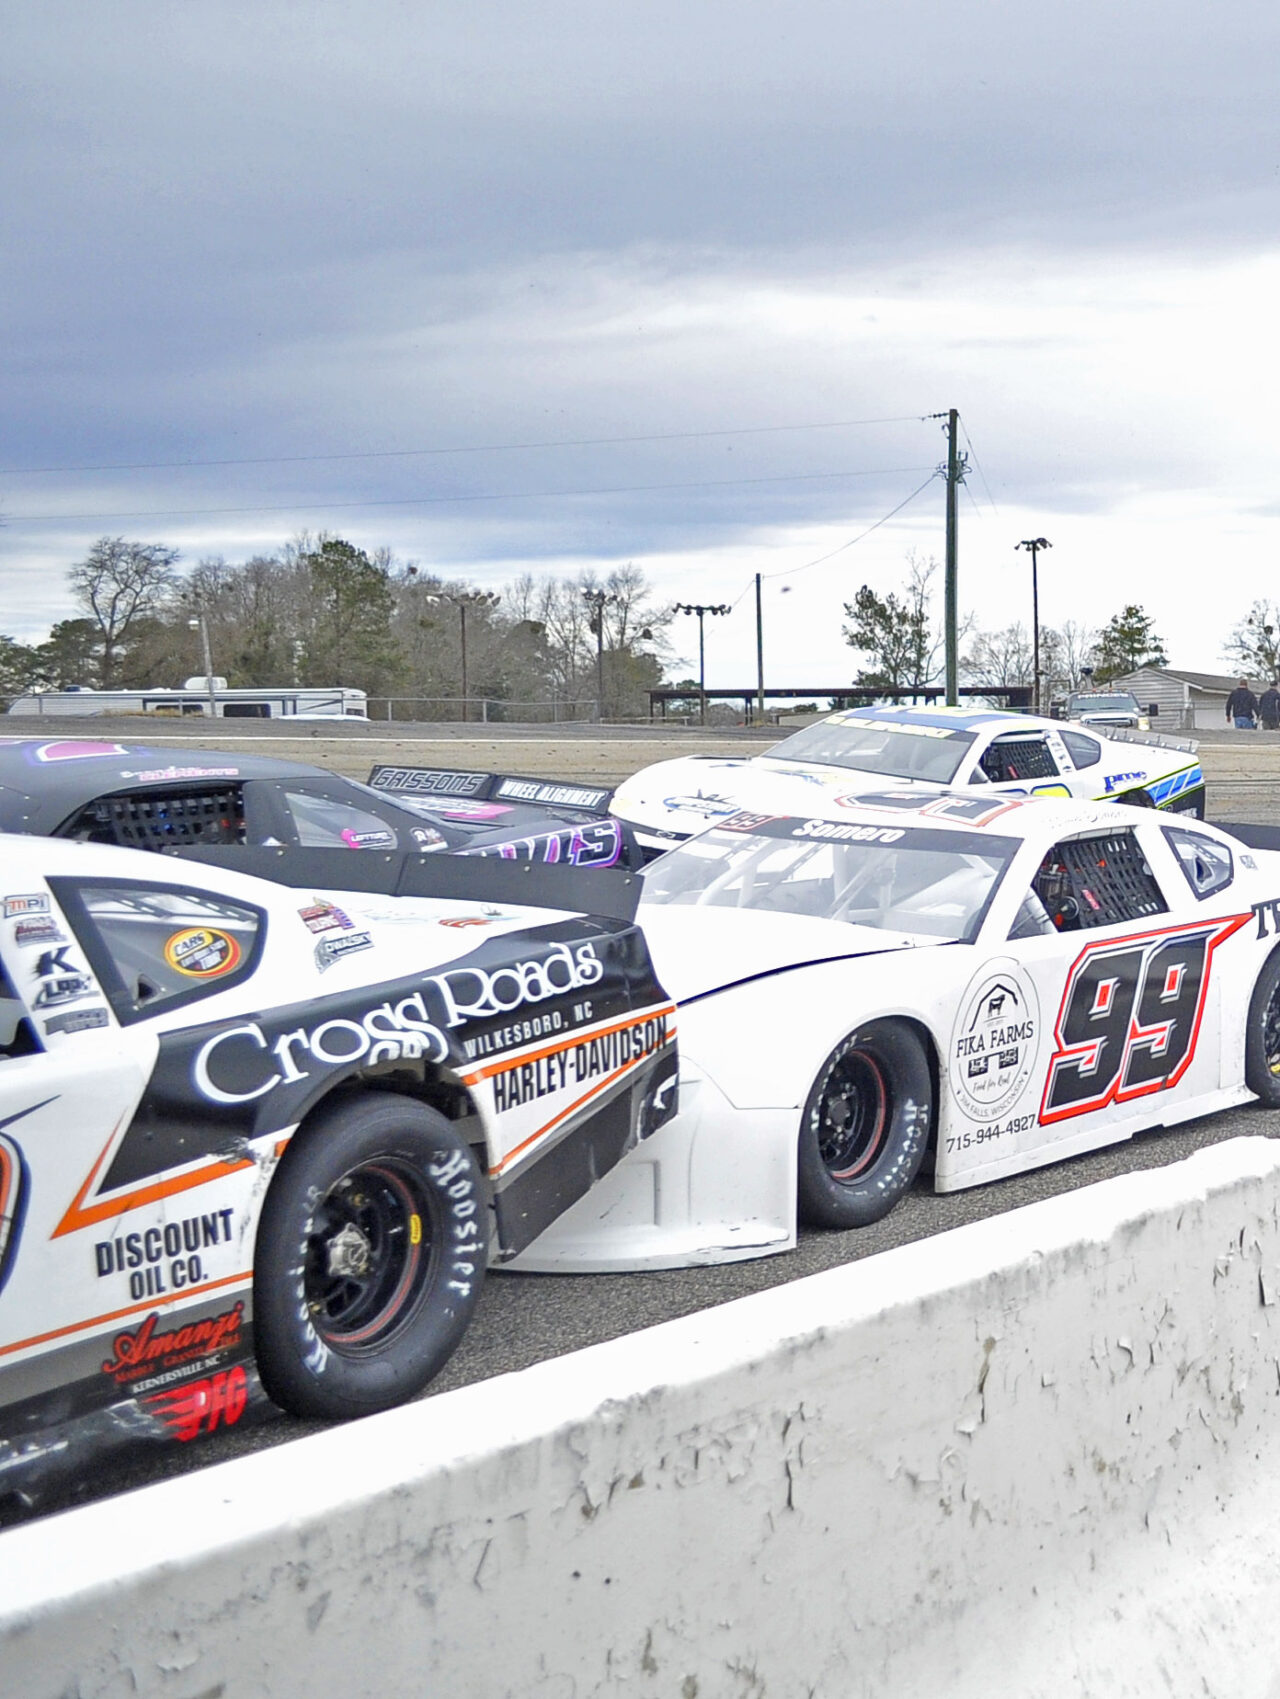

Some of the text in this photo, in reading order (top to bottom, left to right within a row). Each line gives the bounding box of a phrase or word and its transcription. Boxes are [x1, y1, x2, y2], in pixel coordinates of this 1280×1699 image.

[373, 767, 486, 793] GRISSOMS
[498, 780, 606, 807] WHEEL ALIGNMENT
[791, 819, 906, 843] Somero
[194, 942, 604, 1104] Cross Roads
[463, 1010, 569, 1059] WILKESBORO,
[574, 1000, 593, 1023] NC
[956, 1033, 986, 1058] FIKA
[990, 1020, 1034, 1049] FARMS
[1044, 926, 1220, 1118] 99
[492, 1014, 667, 1115] HARLEY-DAVIDSON
[946, 1113, 1036, 1153] 715-944-4927
[95, 1208, 234, 1278] DISCOUNT
[430, 1149, 484, 1297] Hoosier
[130, 1255, 209, 1301] OIL CO.
[102, 1300, 245, 1373] Amanzi
[133, 1354, 221, 1393] KERNERSVILLE NC
